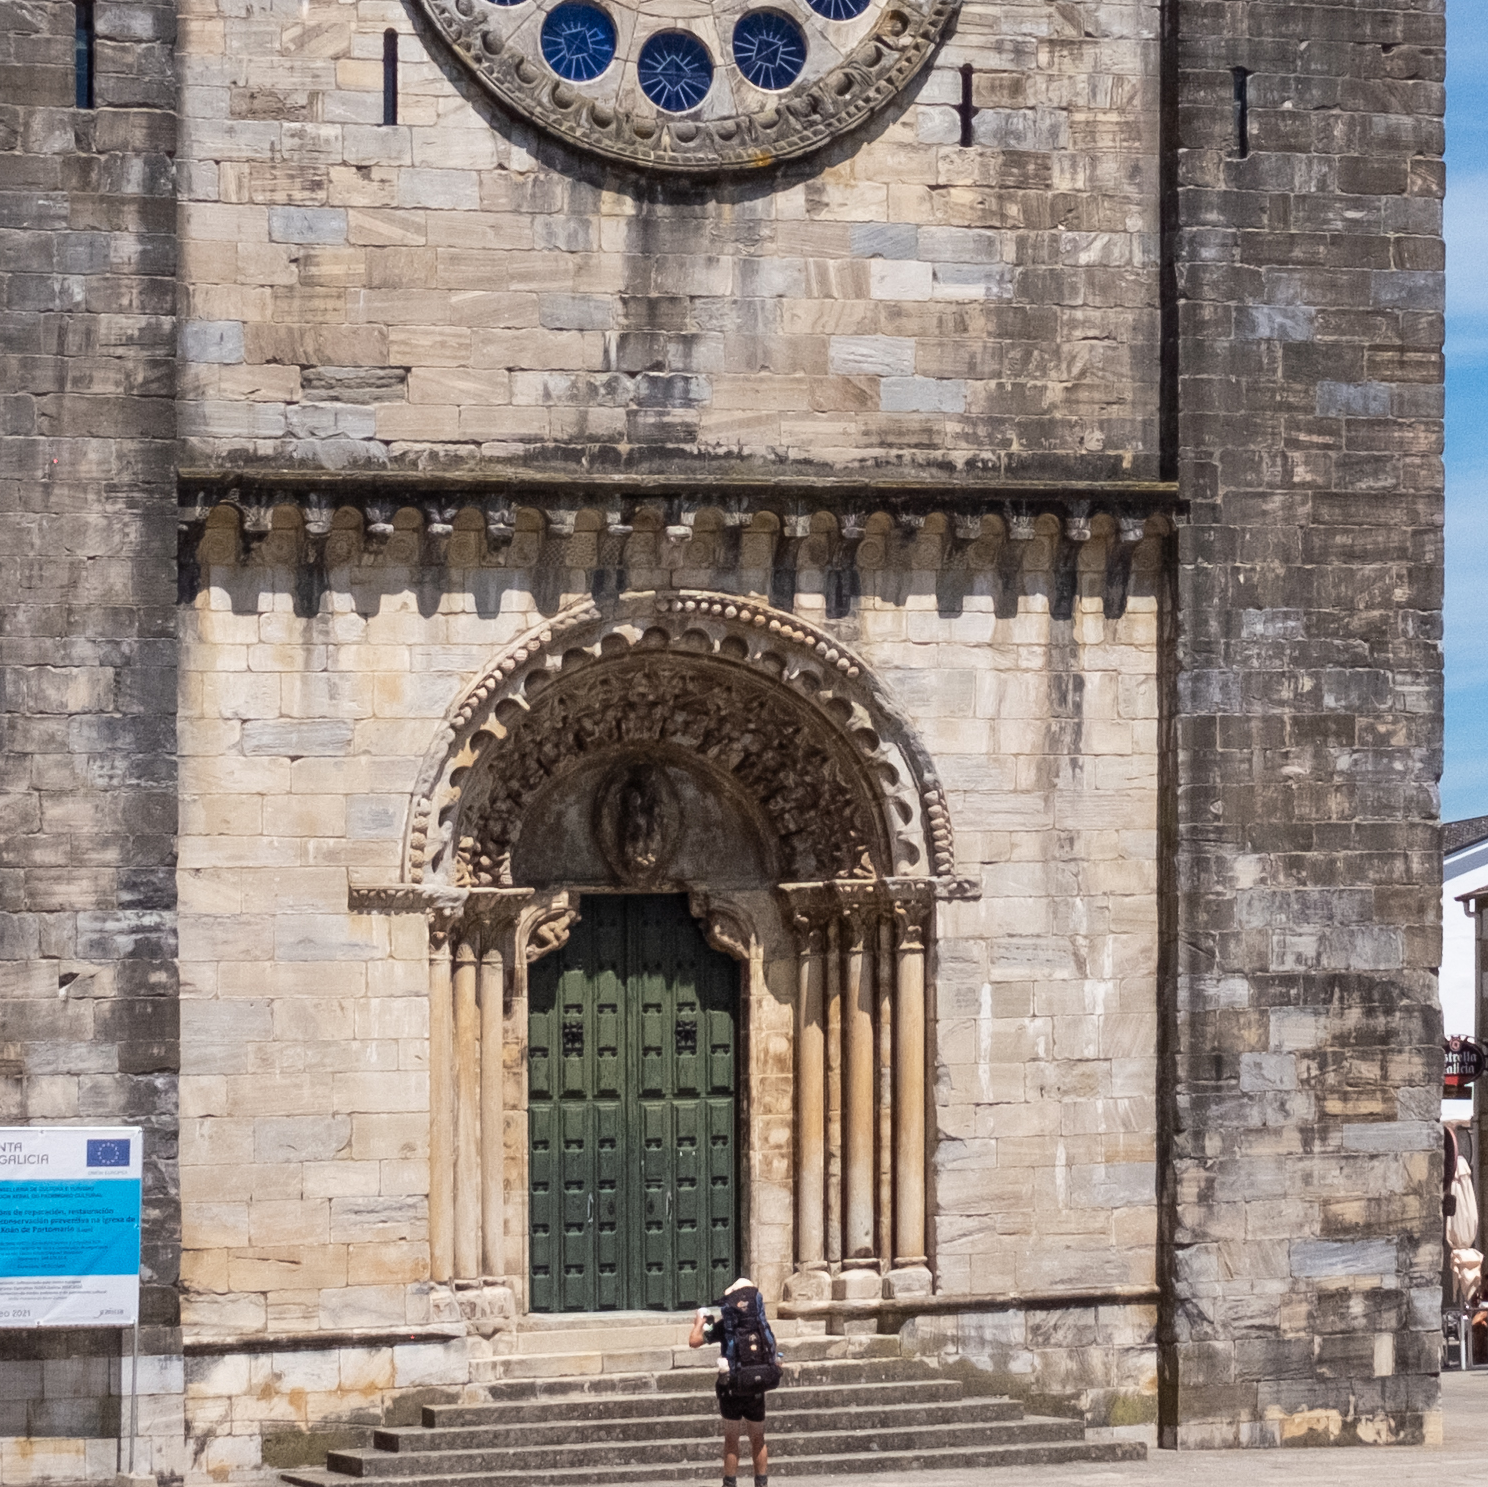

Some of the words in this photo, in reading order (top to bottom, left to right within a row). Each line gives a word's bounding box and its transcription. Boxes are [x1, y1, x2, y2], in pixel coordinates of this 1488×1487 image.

[1444, 1051, 1477, 1063] strella
[1444, 1063, 1475, 1075] alicia
[12, 1309, 31, 1318] 2021
